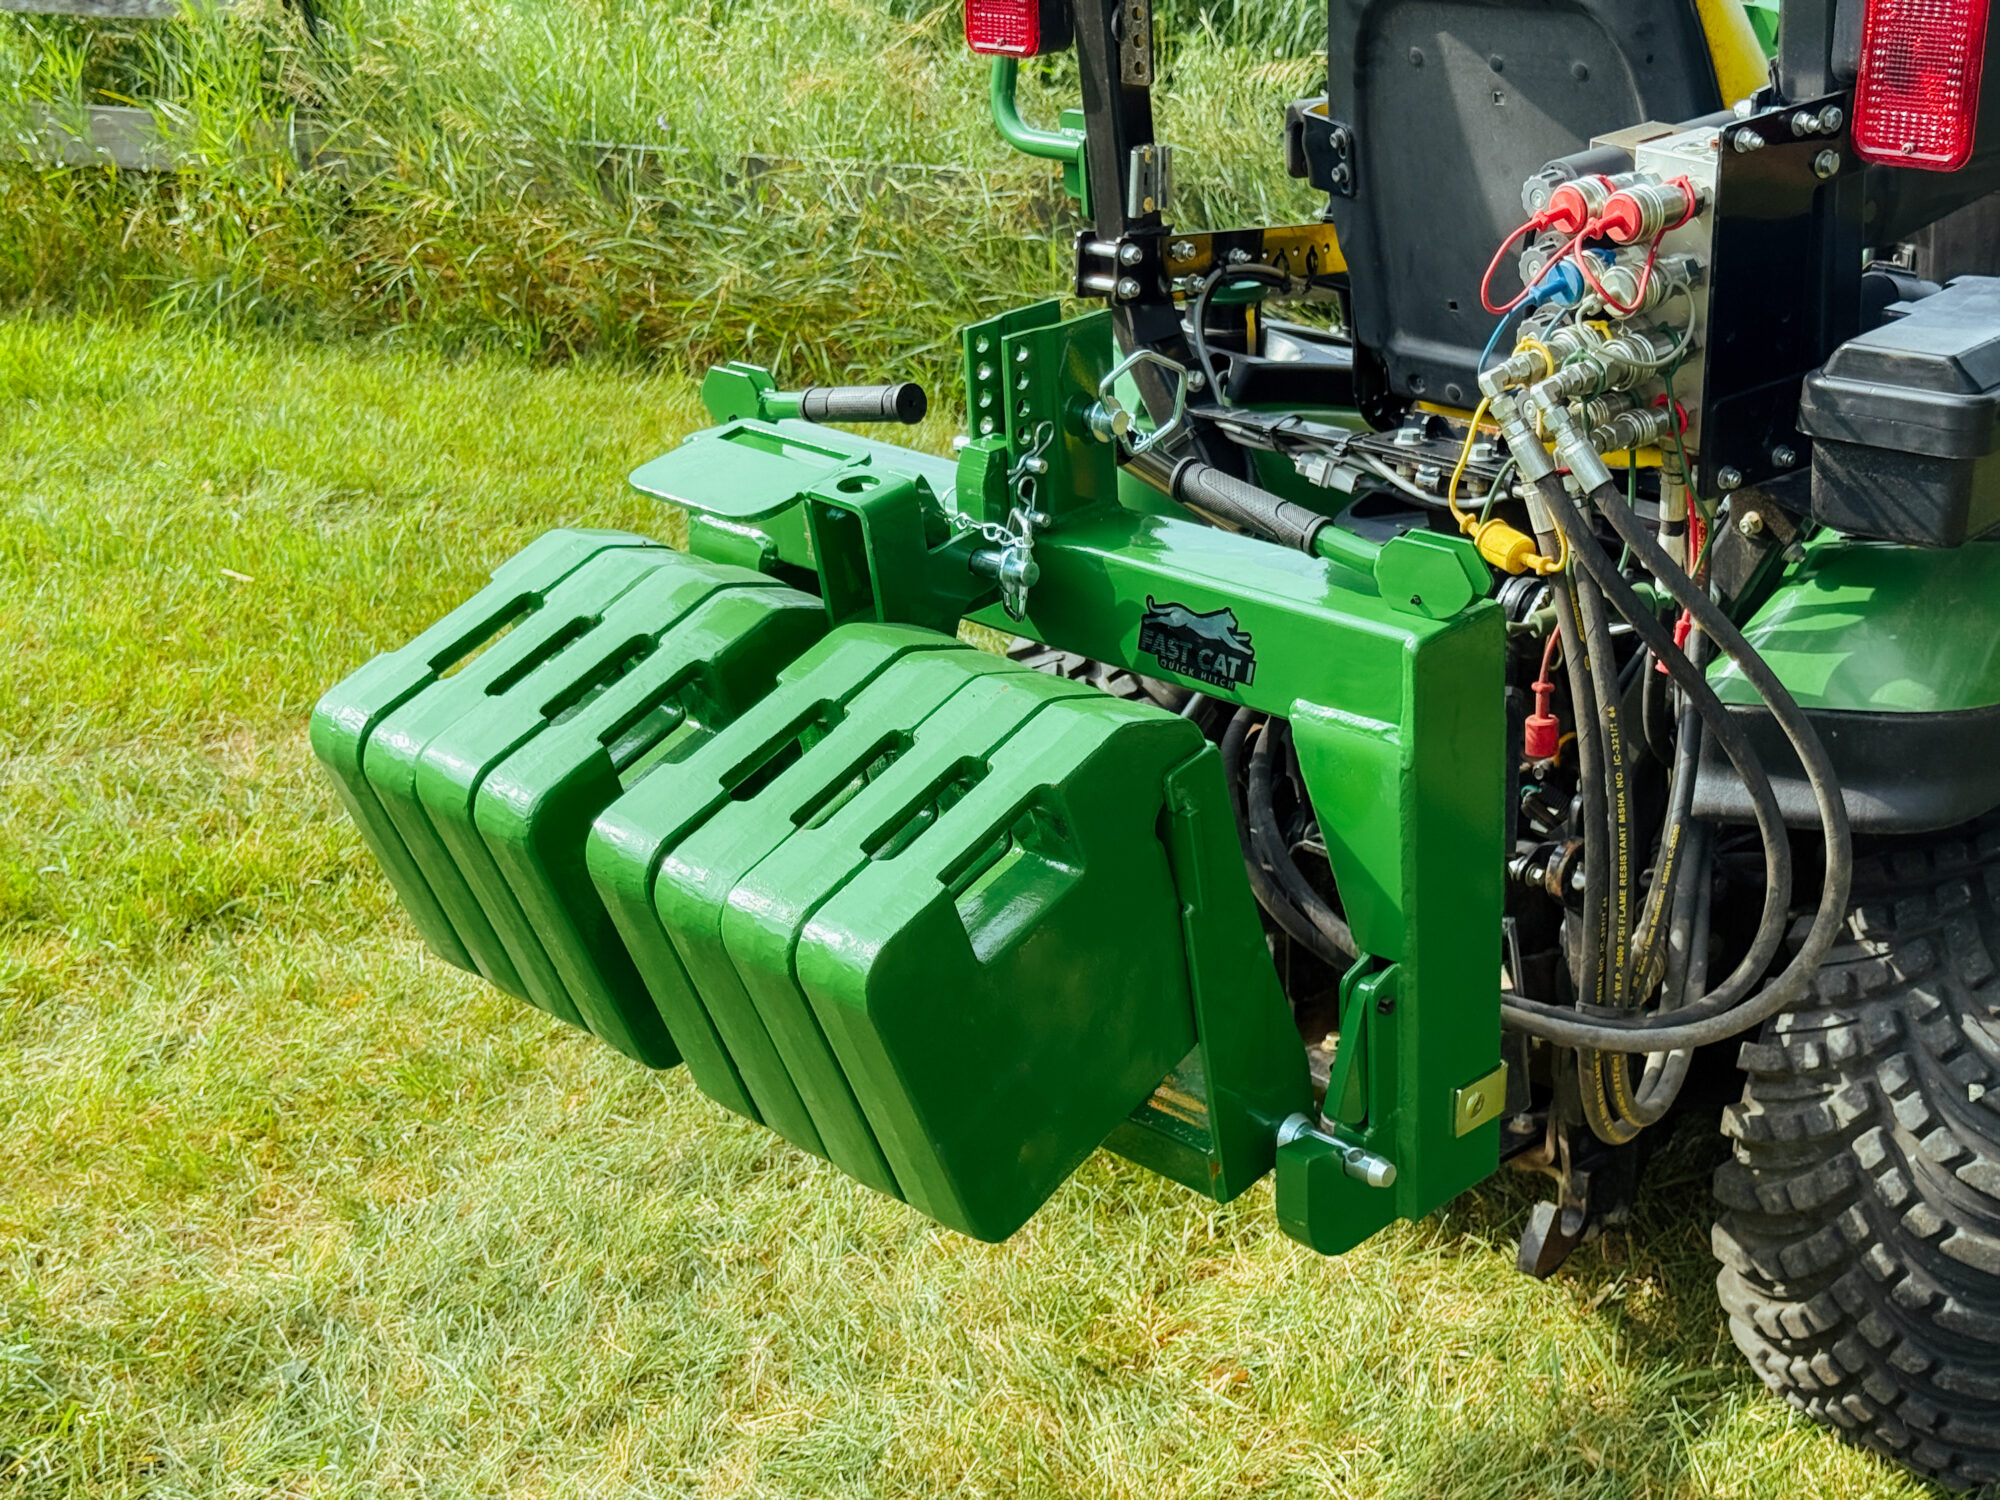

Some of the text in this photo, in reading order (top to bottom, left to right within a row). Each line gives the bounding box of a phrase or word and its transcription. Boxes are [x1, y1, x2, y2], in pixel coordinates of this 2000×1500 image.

[1142, 628, 1192, 664] FAST
[1197, 648, 1241, 679] CAT
[1160, 659, 1234, 689] QUICK HITCH
[1615, 768, 1624, 788] NO.
[1617, 791, 1626, 823] MSHA
[1618, 826, 1628, 887] RESISTANT
[1661, 860, 1673, 884] MSHA
[1618, 889, 1627, 924] FLAME
[1617, 926, 1626, 943] PSI
